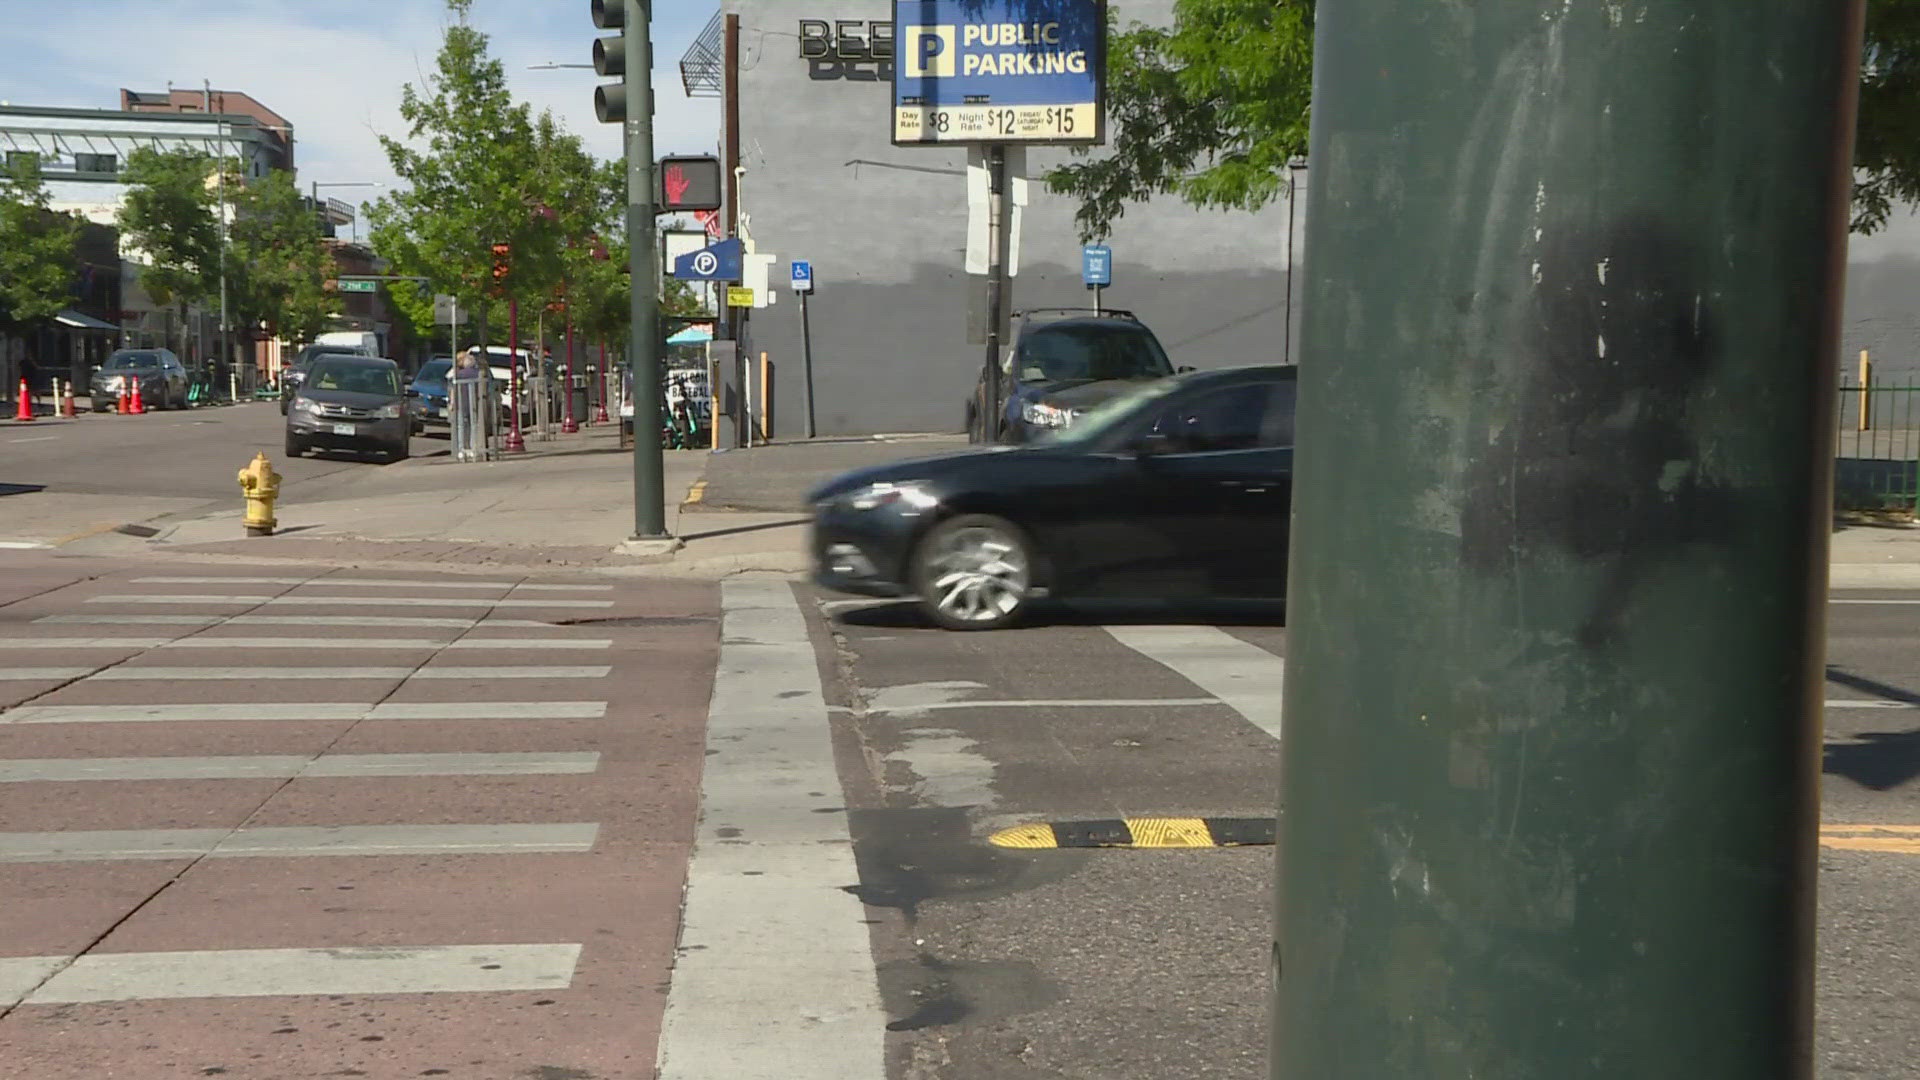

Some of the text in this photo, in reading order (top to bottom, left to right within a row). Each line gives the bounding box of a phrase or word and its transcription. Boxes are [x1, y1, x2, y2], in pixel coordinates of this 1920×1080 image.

[963, 22, 1060, 47] PUBLIC
[918, 33, 945, 71] P
[963, 50, 1087, 76] PARKING
[900, 121, 920, 129] Rate
[902, 112, 919, 120] Day
[929, 111, 950, 133] $8
[959, 113, 984, 123] Night
[960, 122, 983, 131] Rate
[987, 109, 1015, 135] $12
[1046, 107, 1074, 134] $15
[700, 256, 712, 270] P
